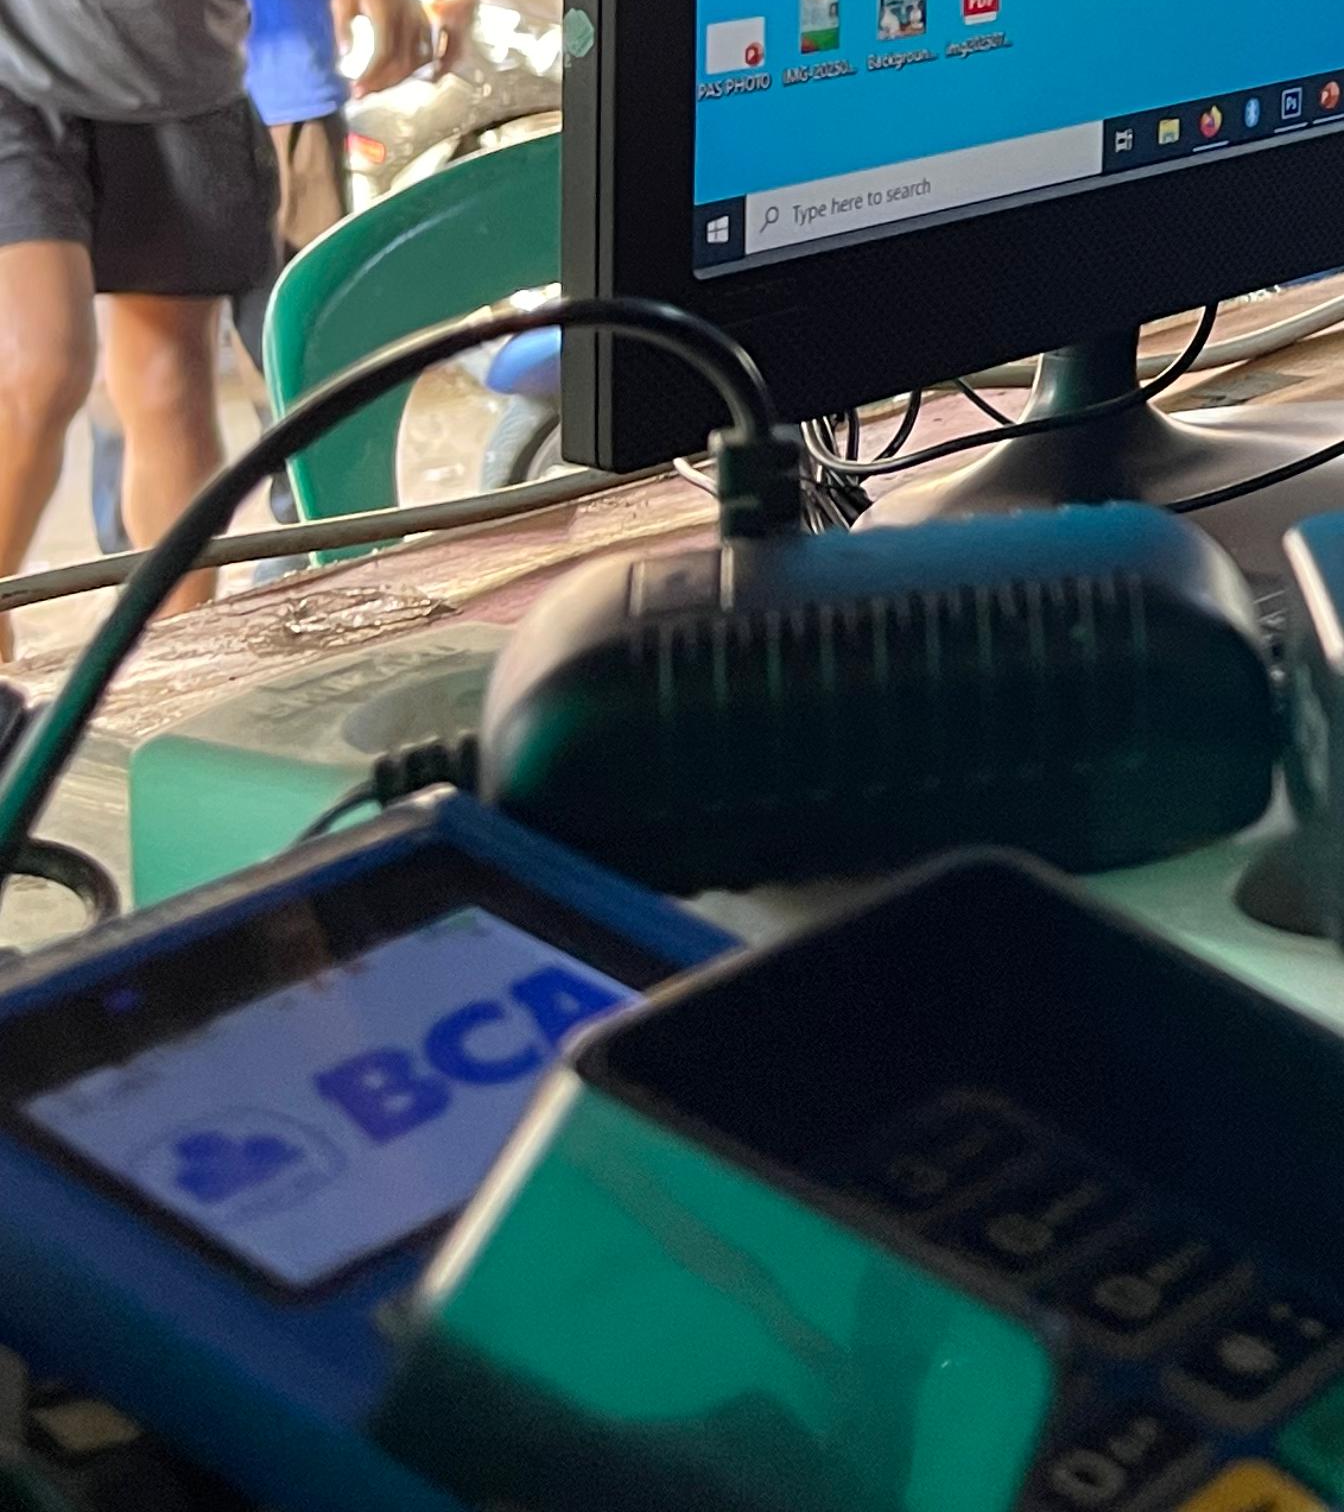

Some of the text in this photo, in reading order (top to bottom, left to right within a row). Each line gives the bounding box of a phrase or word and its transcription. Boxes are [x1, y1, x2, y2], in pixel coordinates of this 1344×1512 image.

[697, 72, 771, 102] PAS PHOTO
[792, 177, 932, 225] Type here to search
[311, 962, 622, 1146] BCA
